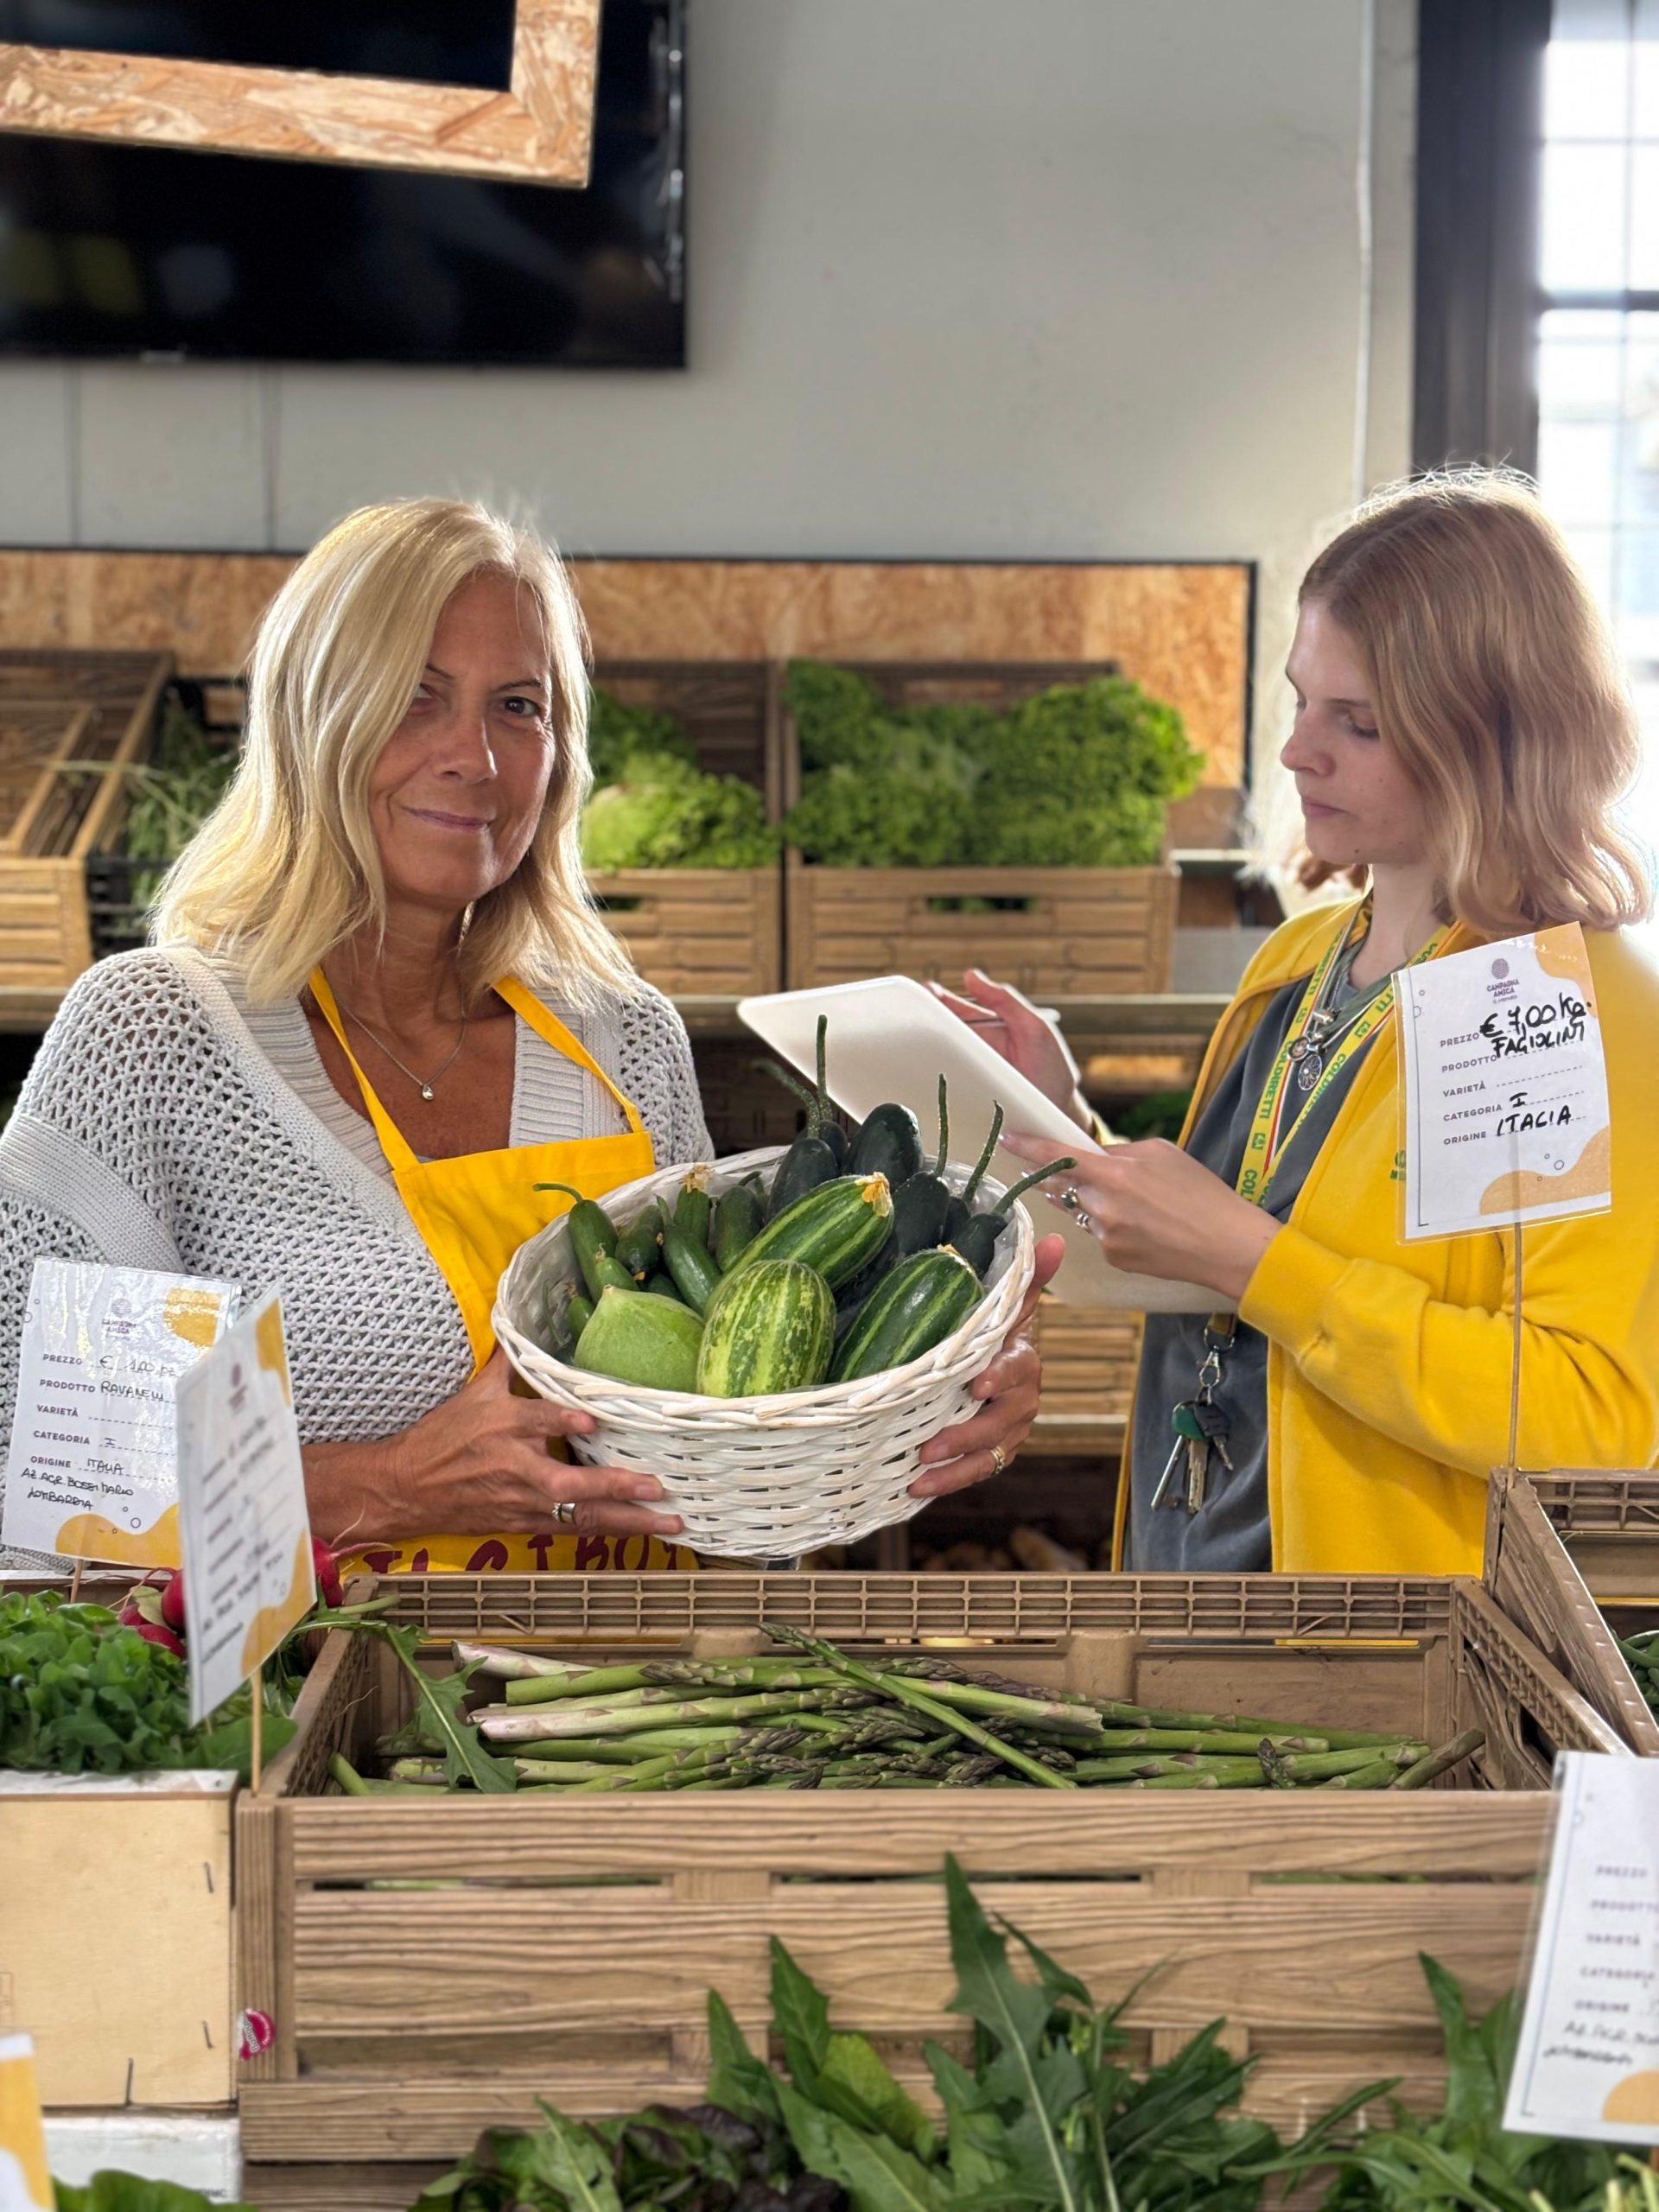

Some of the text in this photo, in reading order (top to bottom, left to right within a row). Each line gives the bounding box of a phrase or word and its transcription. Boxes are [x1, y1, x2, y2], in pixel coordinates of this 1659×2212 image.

[1493, 987, 1516, 997] AMICA
[1440, 1033, 1479, 1047] PREZZO
[1479, 1013, 1504, 1038] €
[1441, 1055, 1497, 1073] PRODOTTO
[1442, 1081, 1486, 1097] VARIETÀ
[1443, 1092, 1528, 1122] CATEGORIA I
[1444, 1131, 1487, 1145] ORIGINE
[42, 1353, 83, 1365] PREZZO
[99, 1355, 113, 1369] €
[40, 1379, 96, 1393] PRODOTTO
[37, 1404, 79, 1417] VARIETÀ
[33, 1430, 91, 1445] CATEGORIA
[30, 1455, 72, 1468] ORIGINE
